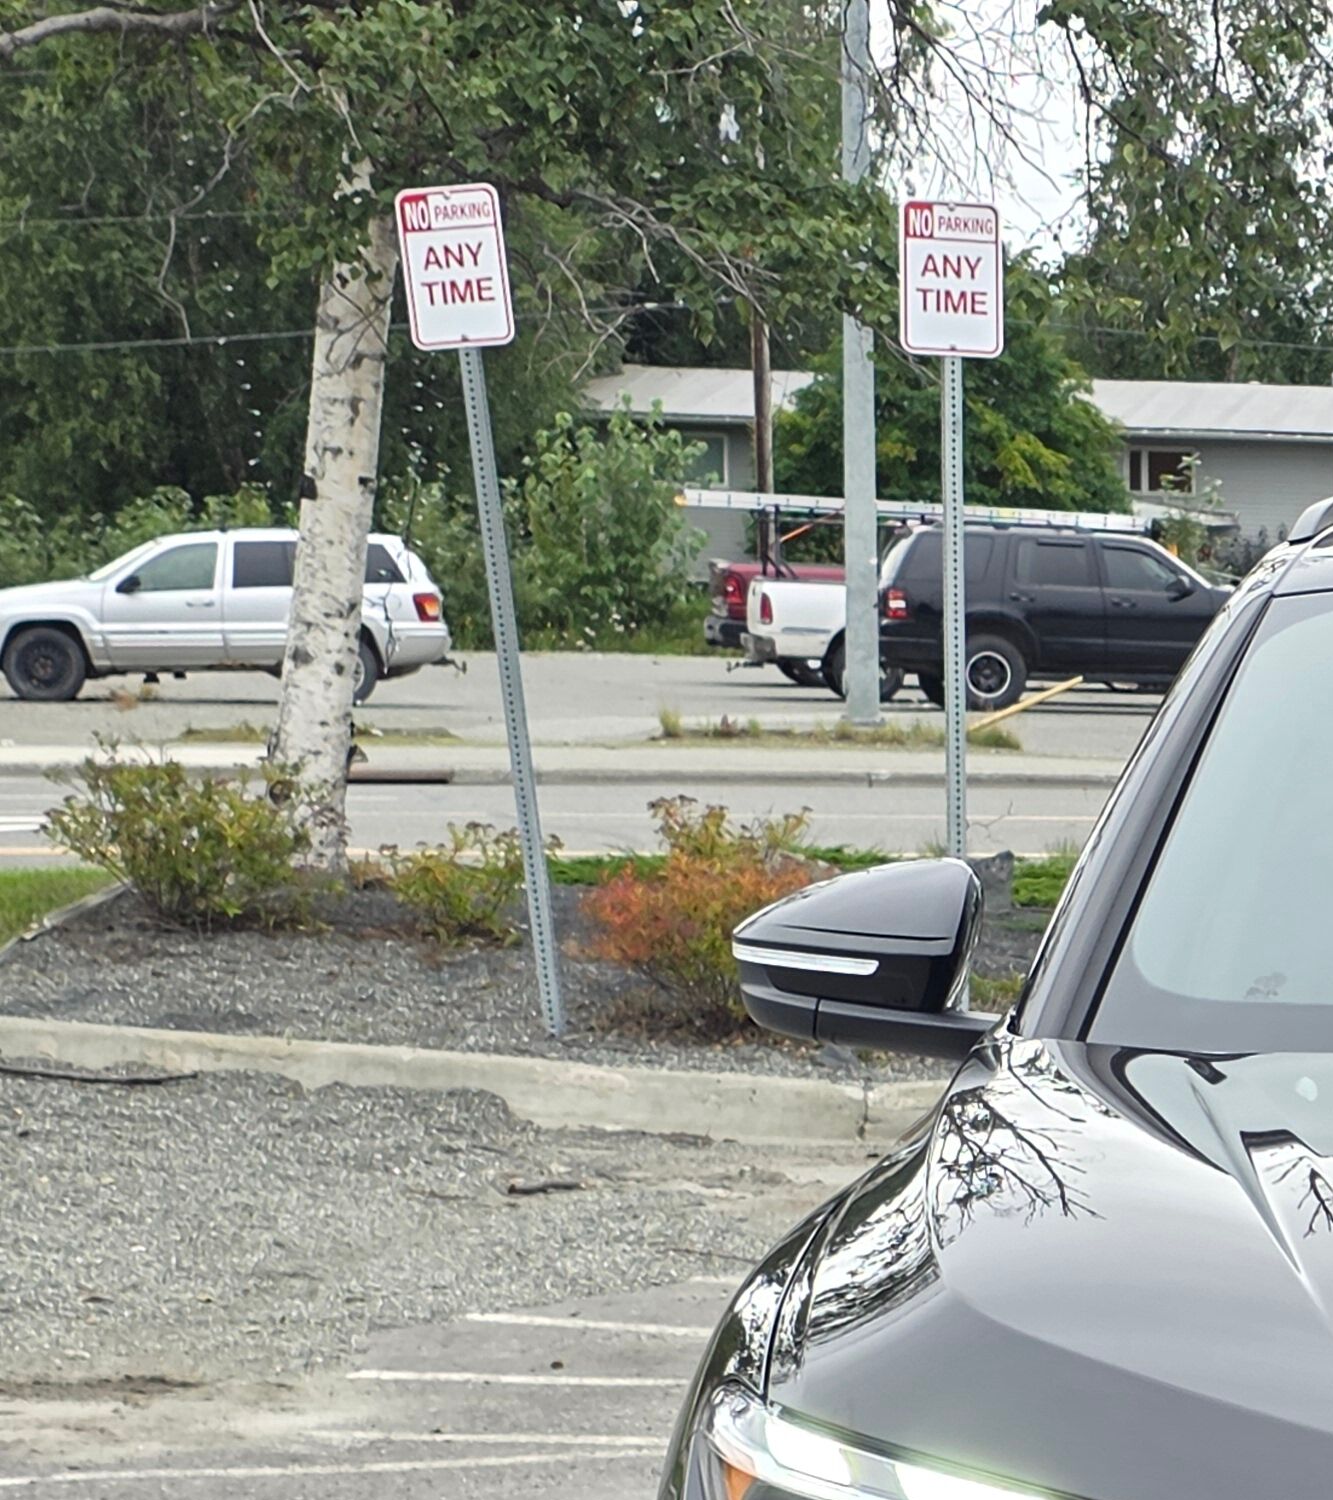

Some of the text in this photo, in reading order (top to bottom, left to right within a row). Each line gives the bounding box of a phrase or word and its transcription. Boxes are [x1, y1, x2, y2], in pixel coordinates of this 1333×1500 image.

[403, 200, 491, 231] NO PARKING
[908, 208, 993, 237] NO PARKING
[424, 241, 483, 271] ANY
[921, 253, 982, 280] ANY
[421, 277, 496, 306] TIME
[915, 287, 988, 316] TIME
